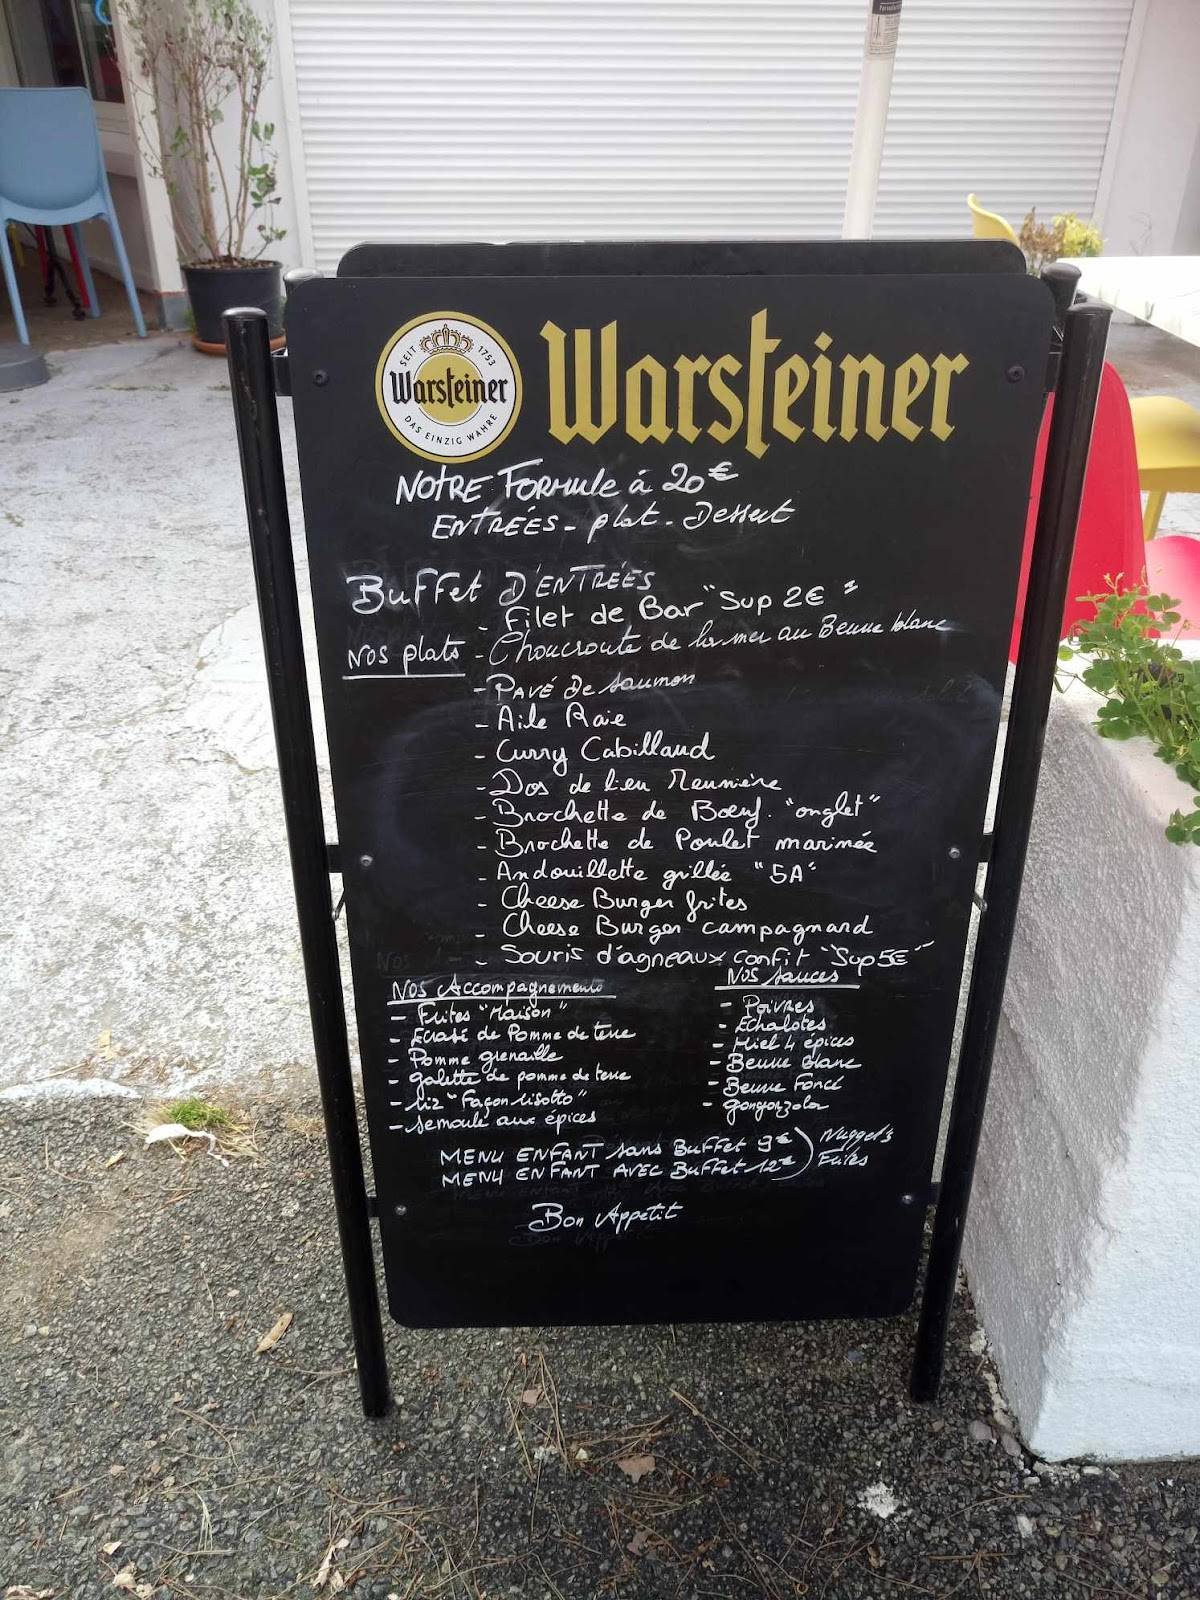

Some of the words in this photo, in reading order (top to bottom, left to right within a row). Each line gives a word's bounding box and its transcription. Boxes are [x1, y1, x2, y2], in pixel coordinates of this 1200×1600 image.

[400, 346, 416, 366] SEIT
[478, 346, 496, 366] 1753
[389, 367, 509, 409] Warsteiner
[539, 308, 970, 459] Warsteiner
[404, 415, 422, 434] DAS
[424, 432, 463, 445] EINZIG
[466, 413, 498, 442] WAHRE
[590, 604, 625, 625] de
[638, 595, 704, 620] Bar
[650, 633, 682, 651] de
[497, 702, 548, 732] Aile
[565, 701, 627, 728] Raie
[496, 738, 569, 777] Curry
[580, 729, 716, 762] Cabillaud
[488, 767, 549, 796] Dos
[568, 773, 592, 795] de
[491, 798, 628, 828] Brochette
[641, 800, 668, 821] de
[494, 826, 610, 858] Brochette
[627, 826, 654, 850] de
[675, 827, 761, 851] Poulet
[500, 882, 585, 910] Cheese
[592, 887, 675, 919] Burger
[502, 910, 580, 938] Cheese
[595, 914, 682, 946] Burger
[701, 914, 875, 946] campagnard
[500, 943, 584, 965] Souris
[476, 1024, 501, 1042] de
[566, 1025, 590, 1041] de
[485, 1067, 510, 1083] de
[496, 1115, 536, 1126] aux
[516, 1142, 605, 1163] ENFANT
[515, 1161, 601, 1181] ENFANT
[528, 1202, 585, 1233] Bon
